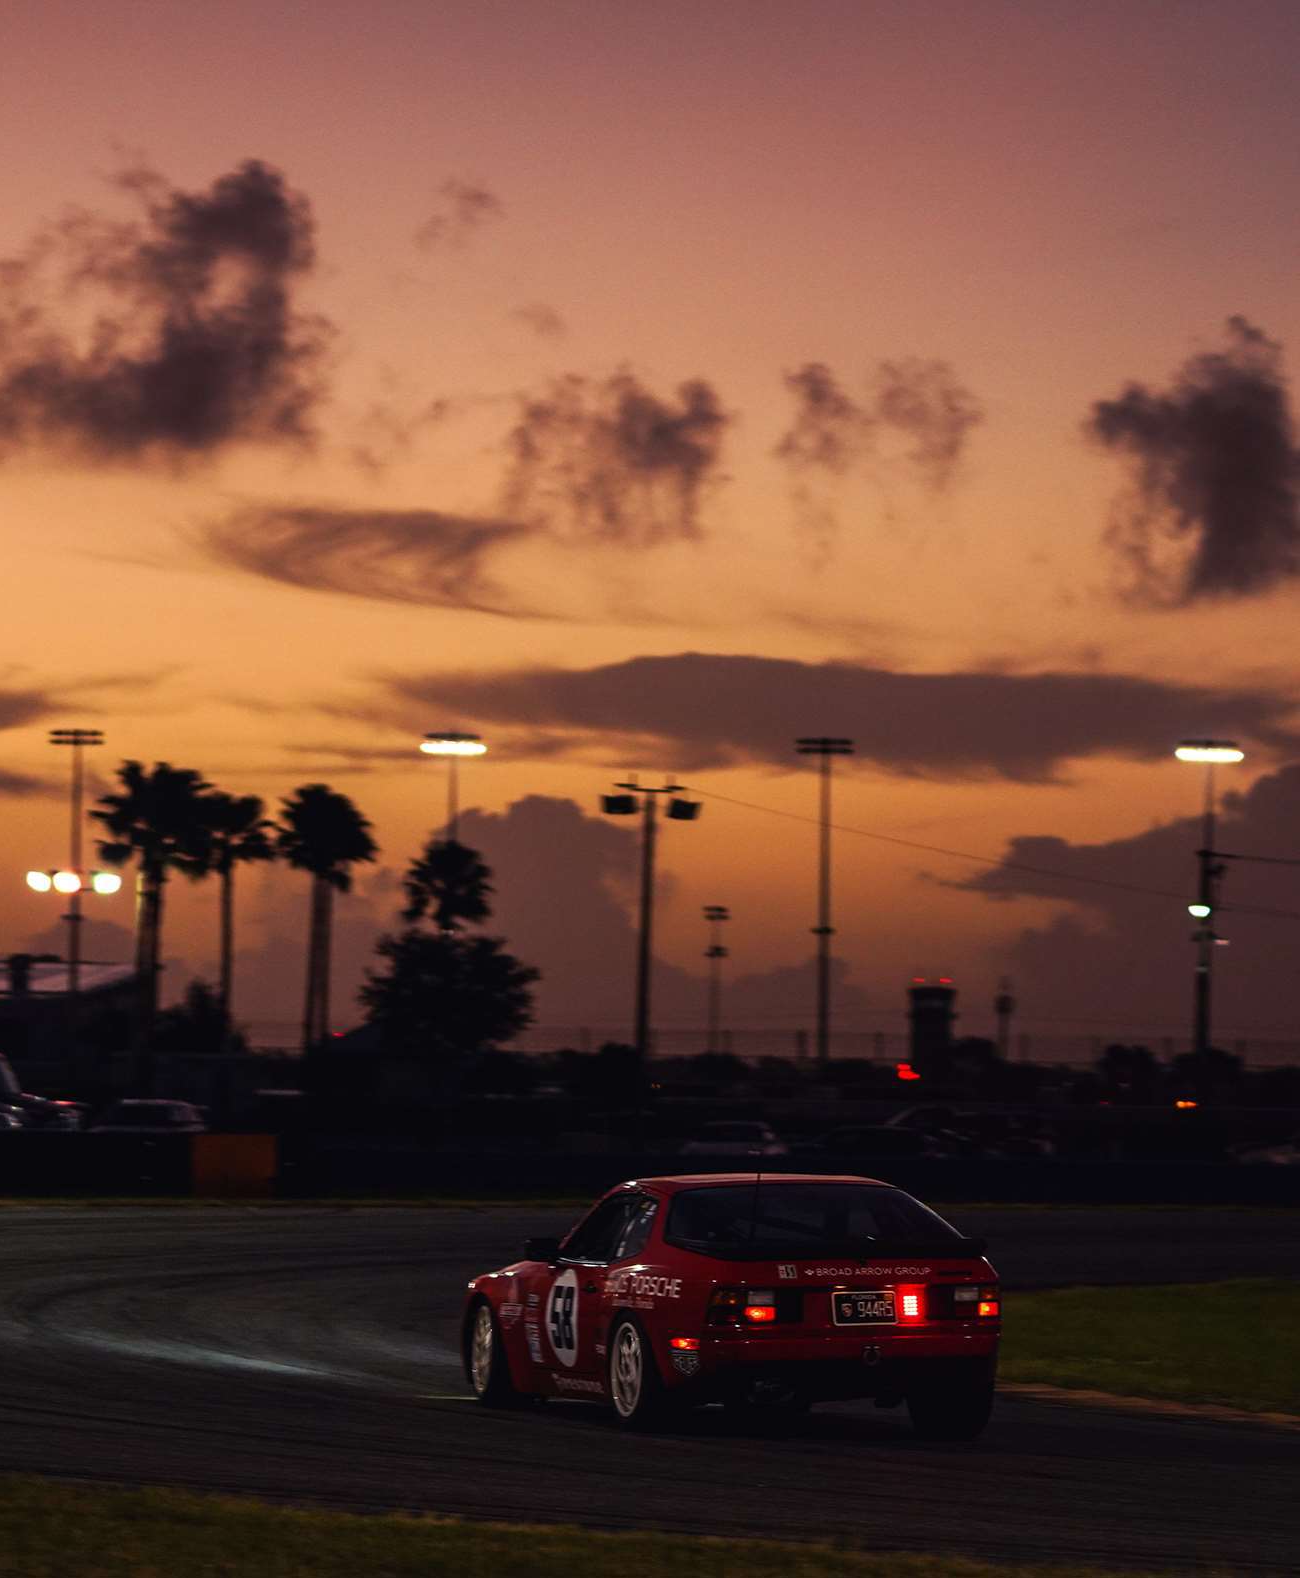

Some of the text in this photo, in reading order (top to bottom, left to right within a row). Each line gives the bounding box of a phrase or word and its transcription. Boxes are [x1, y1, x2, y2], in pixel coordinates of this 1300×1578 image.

[815, 1266, 932, 1276] BROAD ARROW GROUP
[630, 1273, 683, 1298] PORSCHE
[551, 1285, 575, 1350] 58
